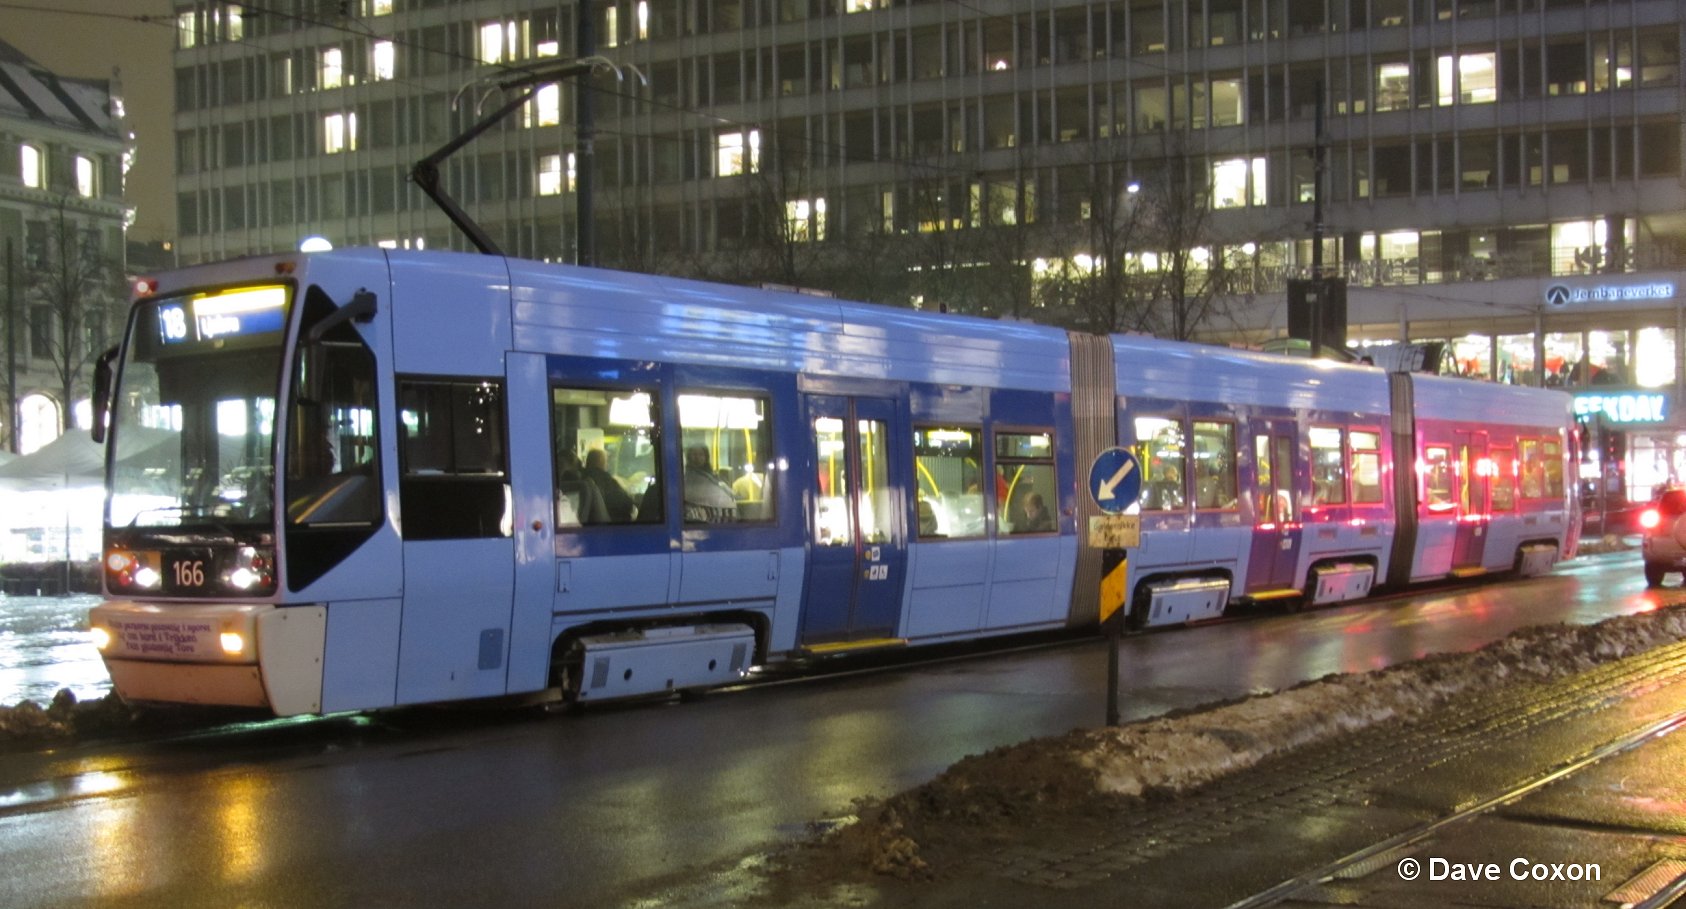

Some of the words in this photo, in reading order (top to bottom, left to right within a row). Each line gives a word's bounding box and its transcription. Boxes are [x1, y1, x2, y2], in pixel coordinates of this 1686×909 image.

[1574, 283, 1671, 300] Jernbaneverket
[162, 307, 187, 340] 18
[1574, 394, 1666, 423] EEKDAY
[172, 560, 205, 587] 166
